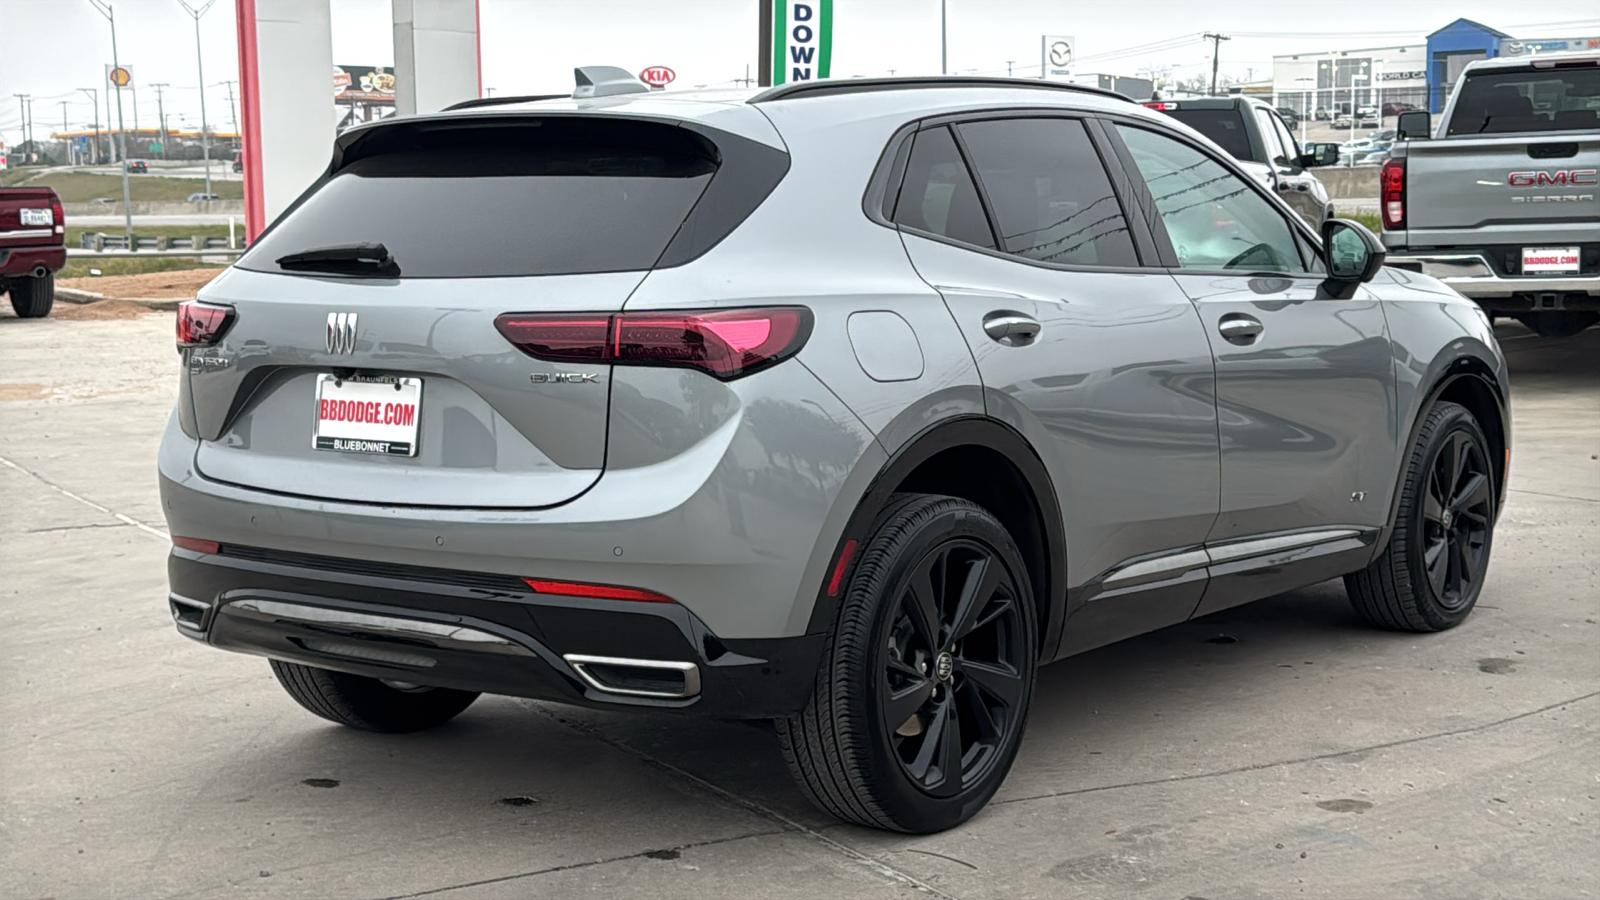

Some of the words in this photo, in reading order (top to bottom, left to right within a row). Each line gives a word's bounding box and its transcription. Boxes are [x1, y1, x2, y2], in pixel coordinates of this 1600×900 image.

[790, 3, 815, 81] DOWN
[647, 70, 671, 82] KIA
[1508, 169, 1597, 187] GMC
[530, 373, 600, 383] BUICK
[320, 399, 415, 427] BBDODGE.COM
[333, 439, 391, 453] BLUEBONNET
